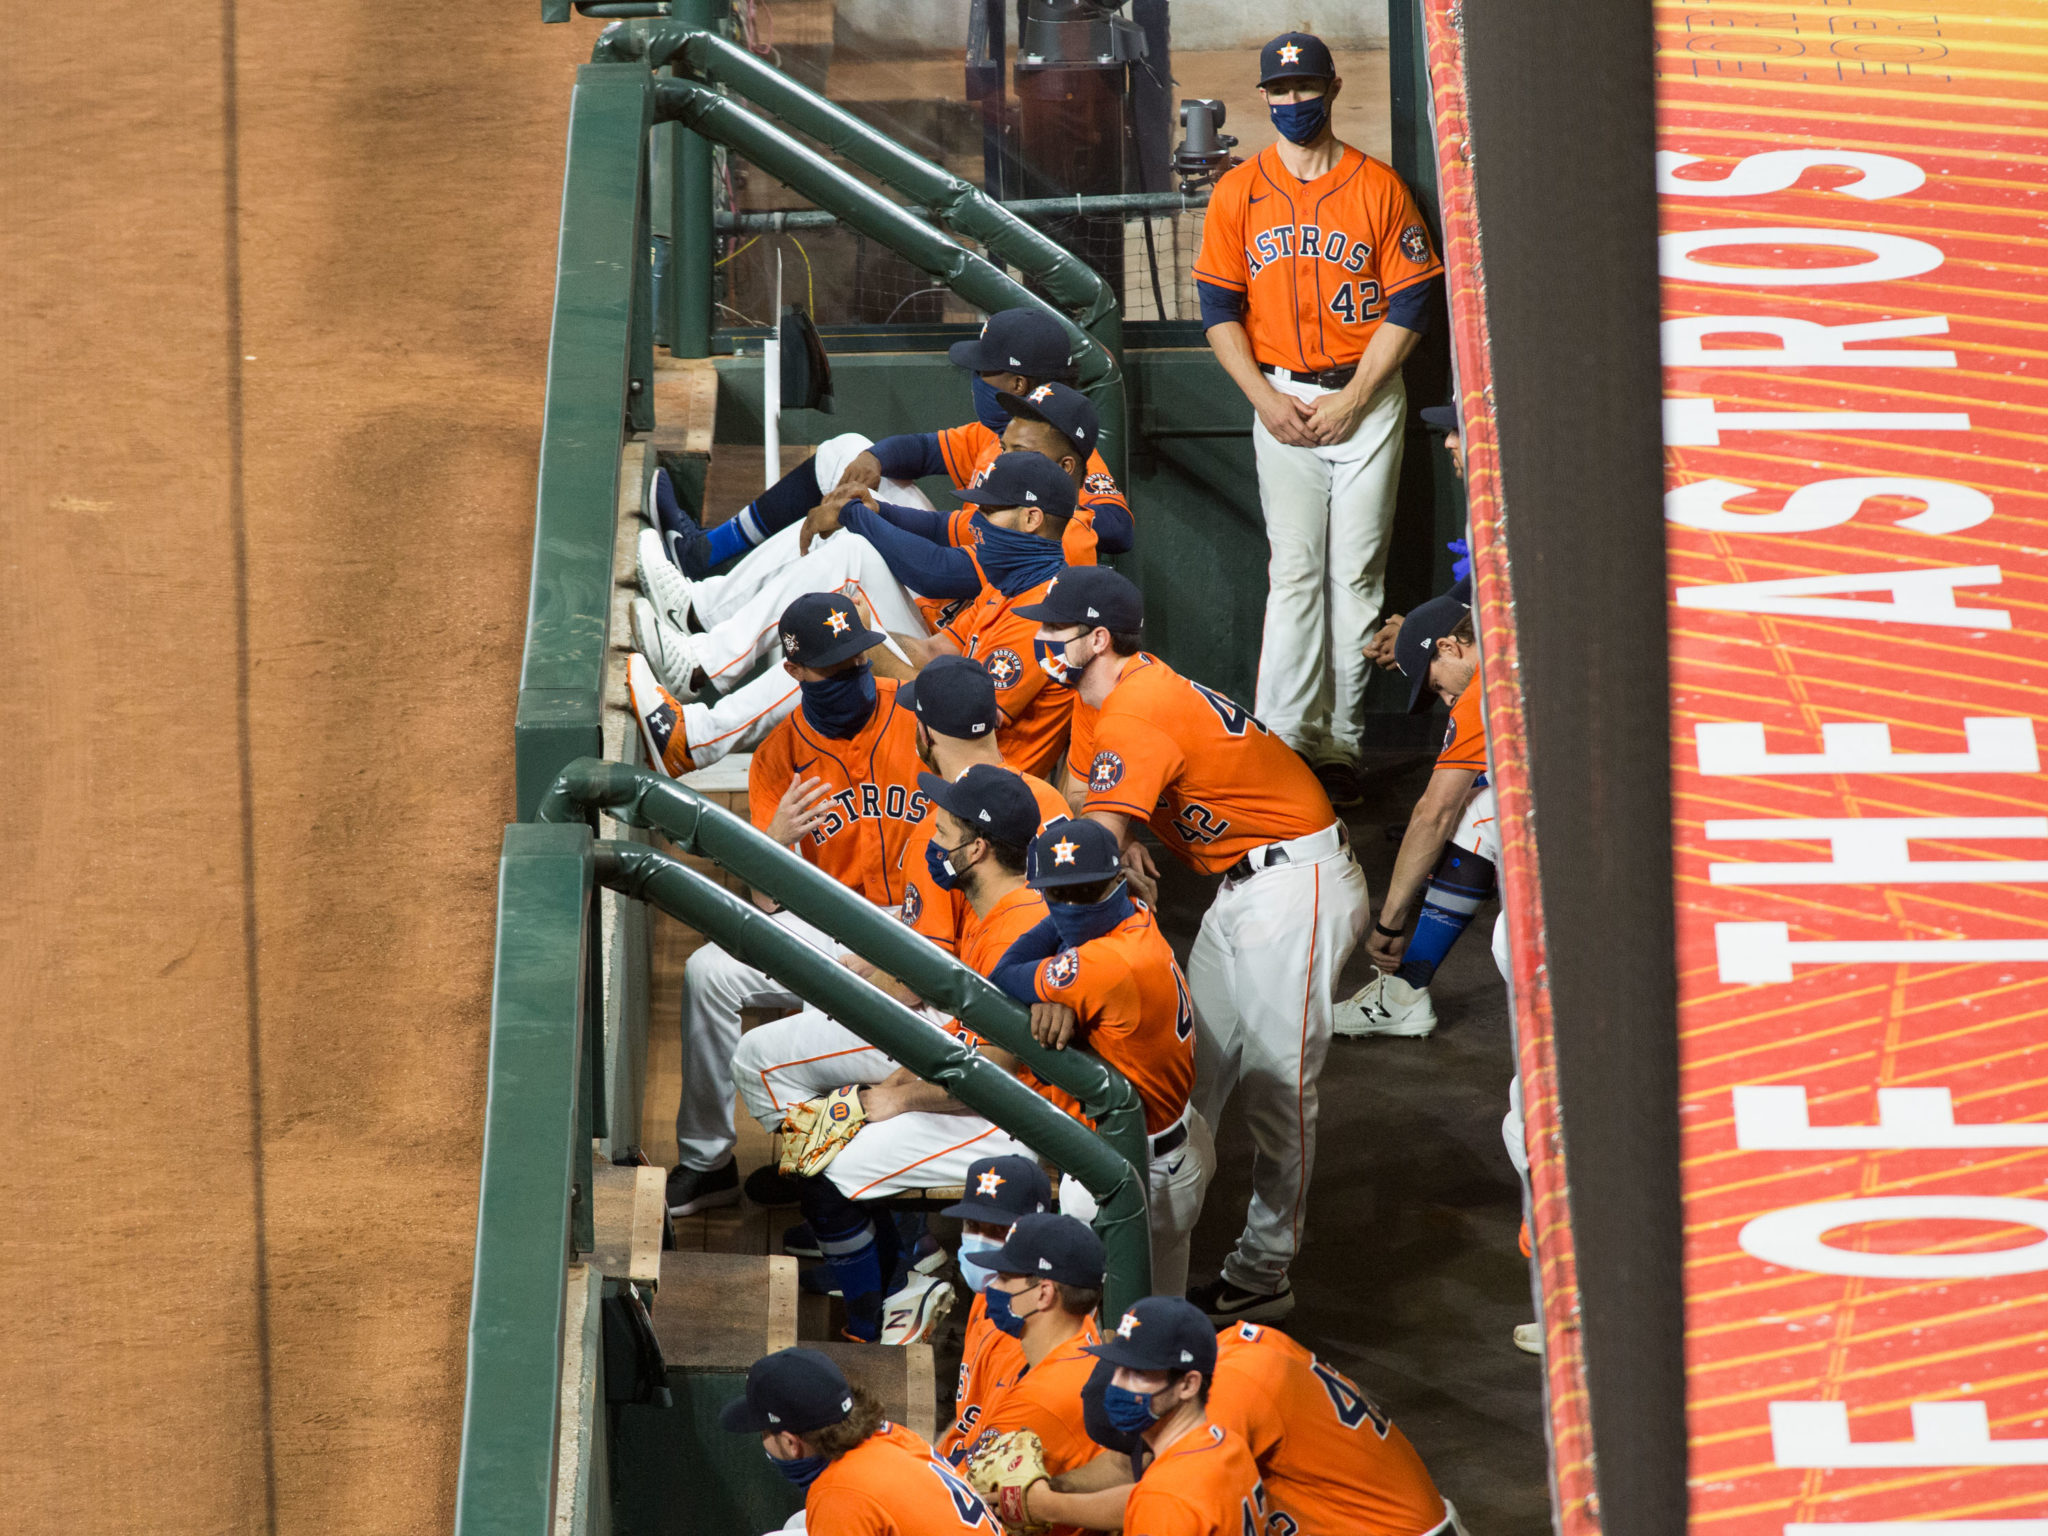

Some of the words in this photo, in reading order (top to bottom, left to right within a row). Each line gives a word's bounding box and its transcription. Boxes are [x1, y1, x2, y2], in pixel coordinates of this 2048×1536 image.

[1246, 224, 1371, 280] ASTROS
[1330, 280, 1382, 323] 42
[1656, 148, 2011, 629] ASTROS
[1171, 804, 1230, 845] 42
[1695, 717, 2048, 983] THE
[1732, 1085, 2048, 1279] OF
